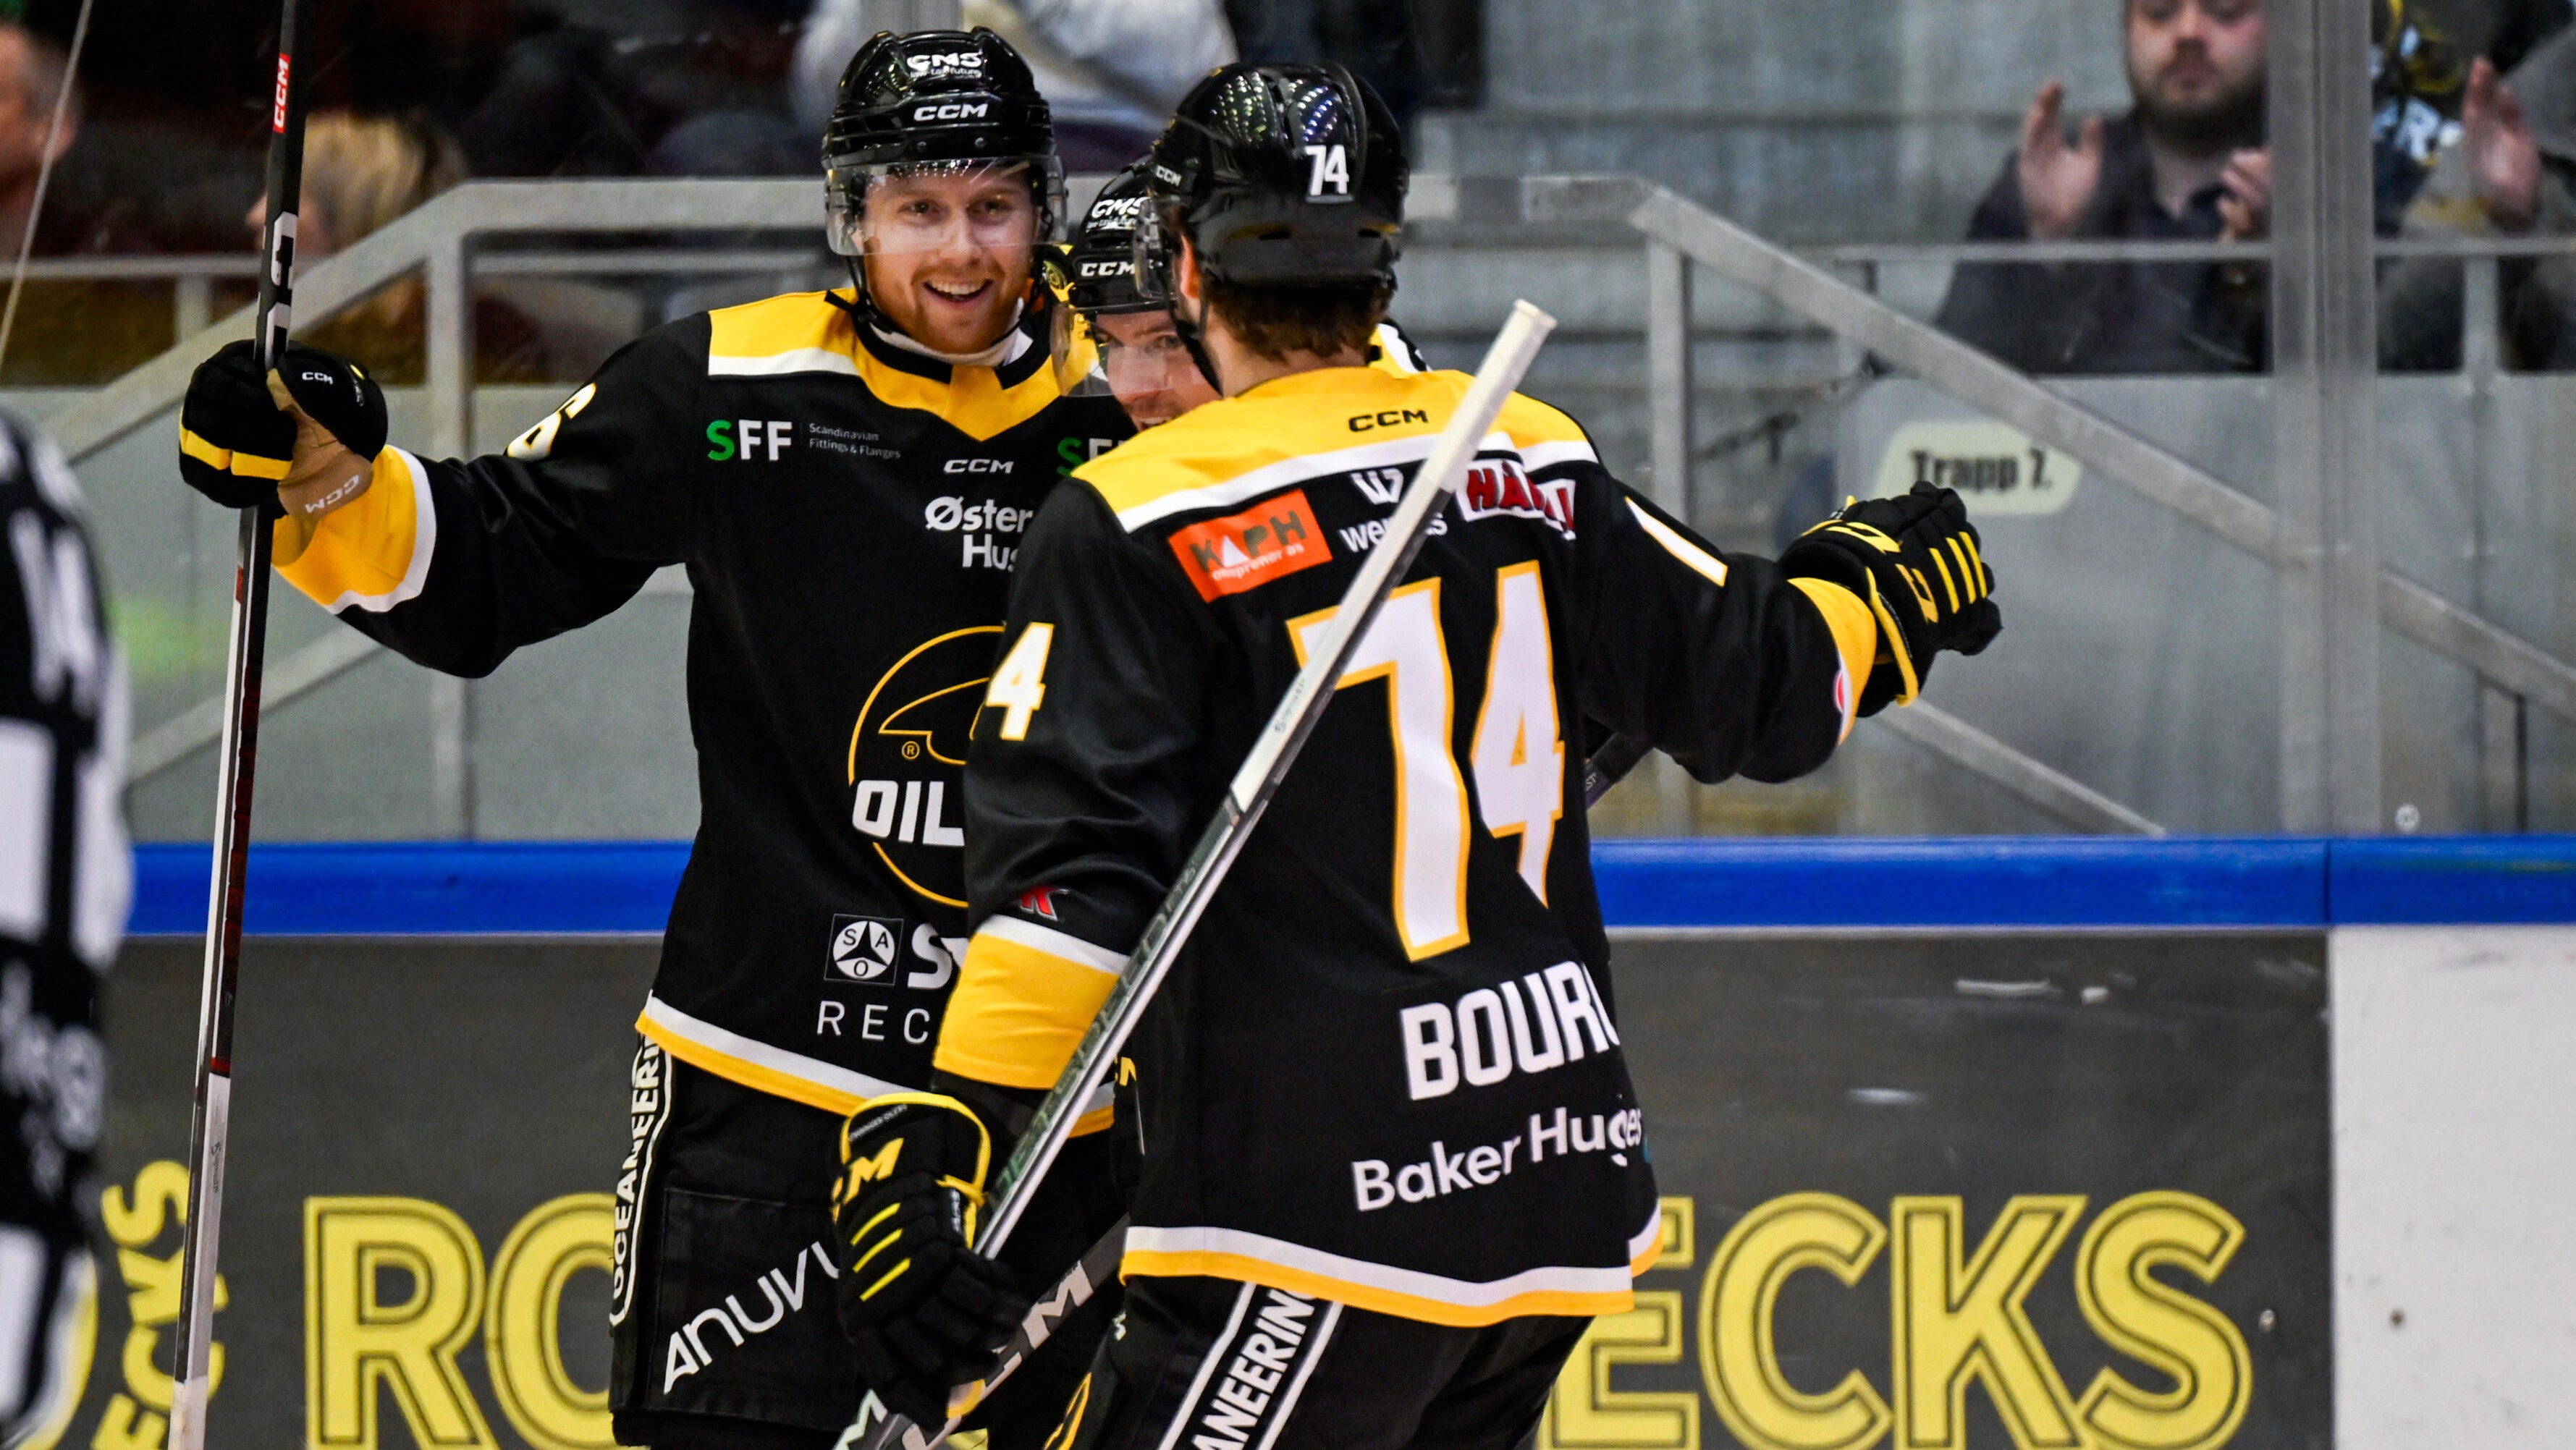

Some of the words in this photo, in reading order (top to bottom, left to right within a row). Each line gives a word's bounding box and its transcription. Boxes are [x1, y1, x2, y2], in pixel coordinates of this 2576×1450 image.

[273, 57, 290, 129] CCM
[913, 103, 989, 122] CCM
[1304, 144, 1350, 196] 74
[302, 371, 334, 385] CCM
[706, 419, 793, 461] SFF
[809, 423, 879, 441] Scandinavian
[1348, 410, 1429, 433] CCM
[809, 438, 848, 453] Fittings
[859, 446, 901, 459] Flanges
[943, 459, 1014, 473] CCM
[1057, 436, 1128, 478] SF
[305, 474, 360, 514] CCM
[924, 496, 1034, 532] Øster
[986, 622, 1054, 741] 4
[1285, 559, 1565, 962] 74
[816, 1001, 931, 1043] REC
[1351, 1140, 1521, 1212] Baker
[1191, 1286, 1317, 1449] ANEERIN
